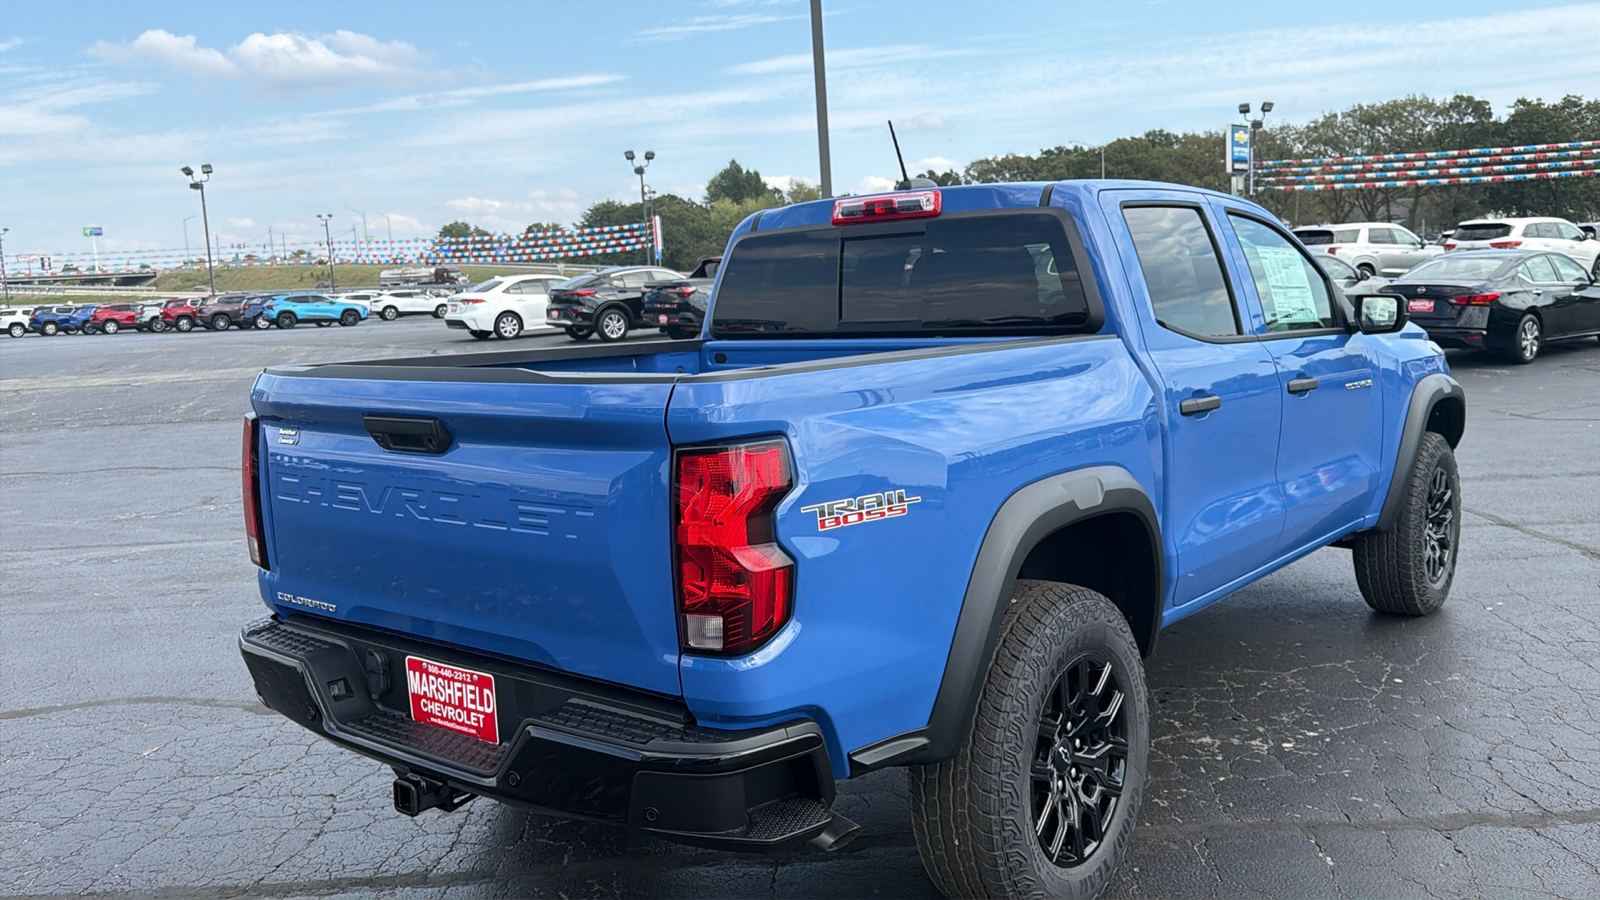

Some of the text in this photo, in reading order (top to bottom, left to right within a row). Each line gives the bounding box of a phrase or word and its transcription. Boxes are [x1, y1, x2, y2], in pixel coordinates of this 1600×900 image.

[277, 472, 594, 539] CHEVROLET
[801, 489, 921, 519] TRAIL
[818, 503, 907, 531] BOSS
[277, 591, 337, 612] COLORADO
[409, 670, 494, 714] MARSHFIELD
[420, 698, 485, 728] CHEVROLET
